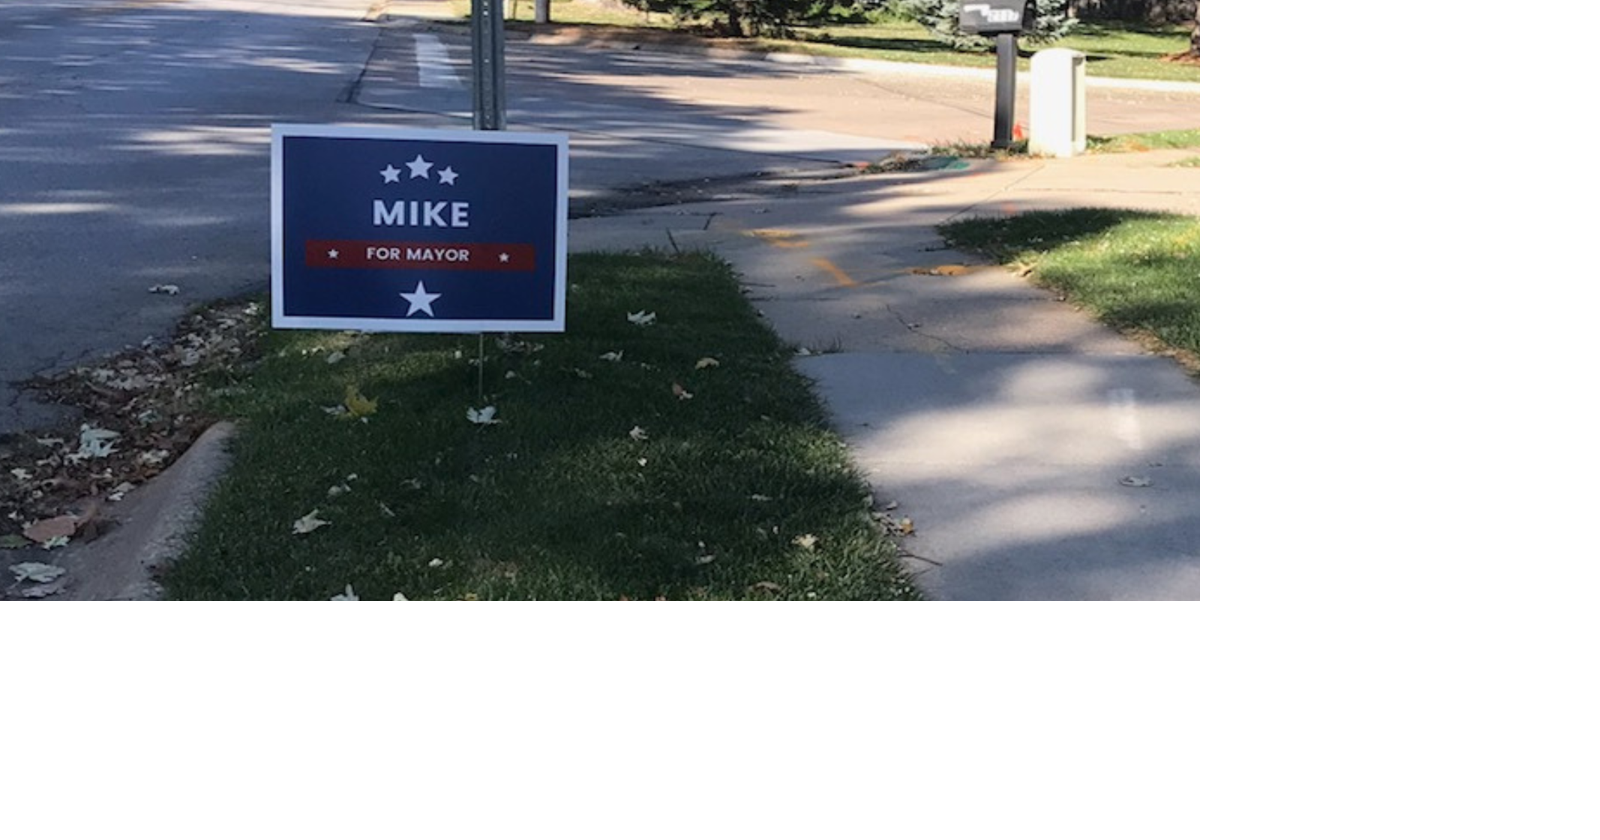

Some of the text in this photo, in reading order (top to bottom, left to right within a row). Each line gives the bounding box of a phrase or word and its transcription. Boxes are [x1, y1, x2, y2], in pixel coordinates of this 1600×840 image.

[374, 200, 469, 227] MIKE
[366, 247, 469, 262] FOR MAYOR
